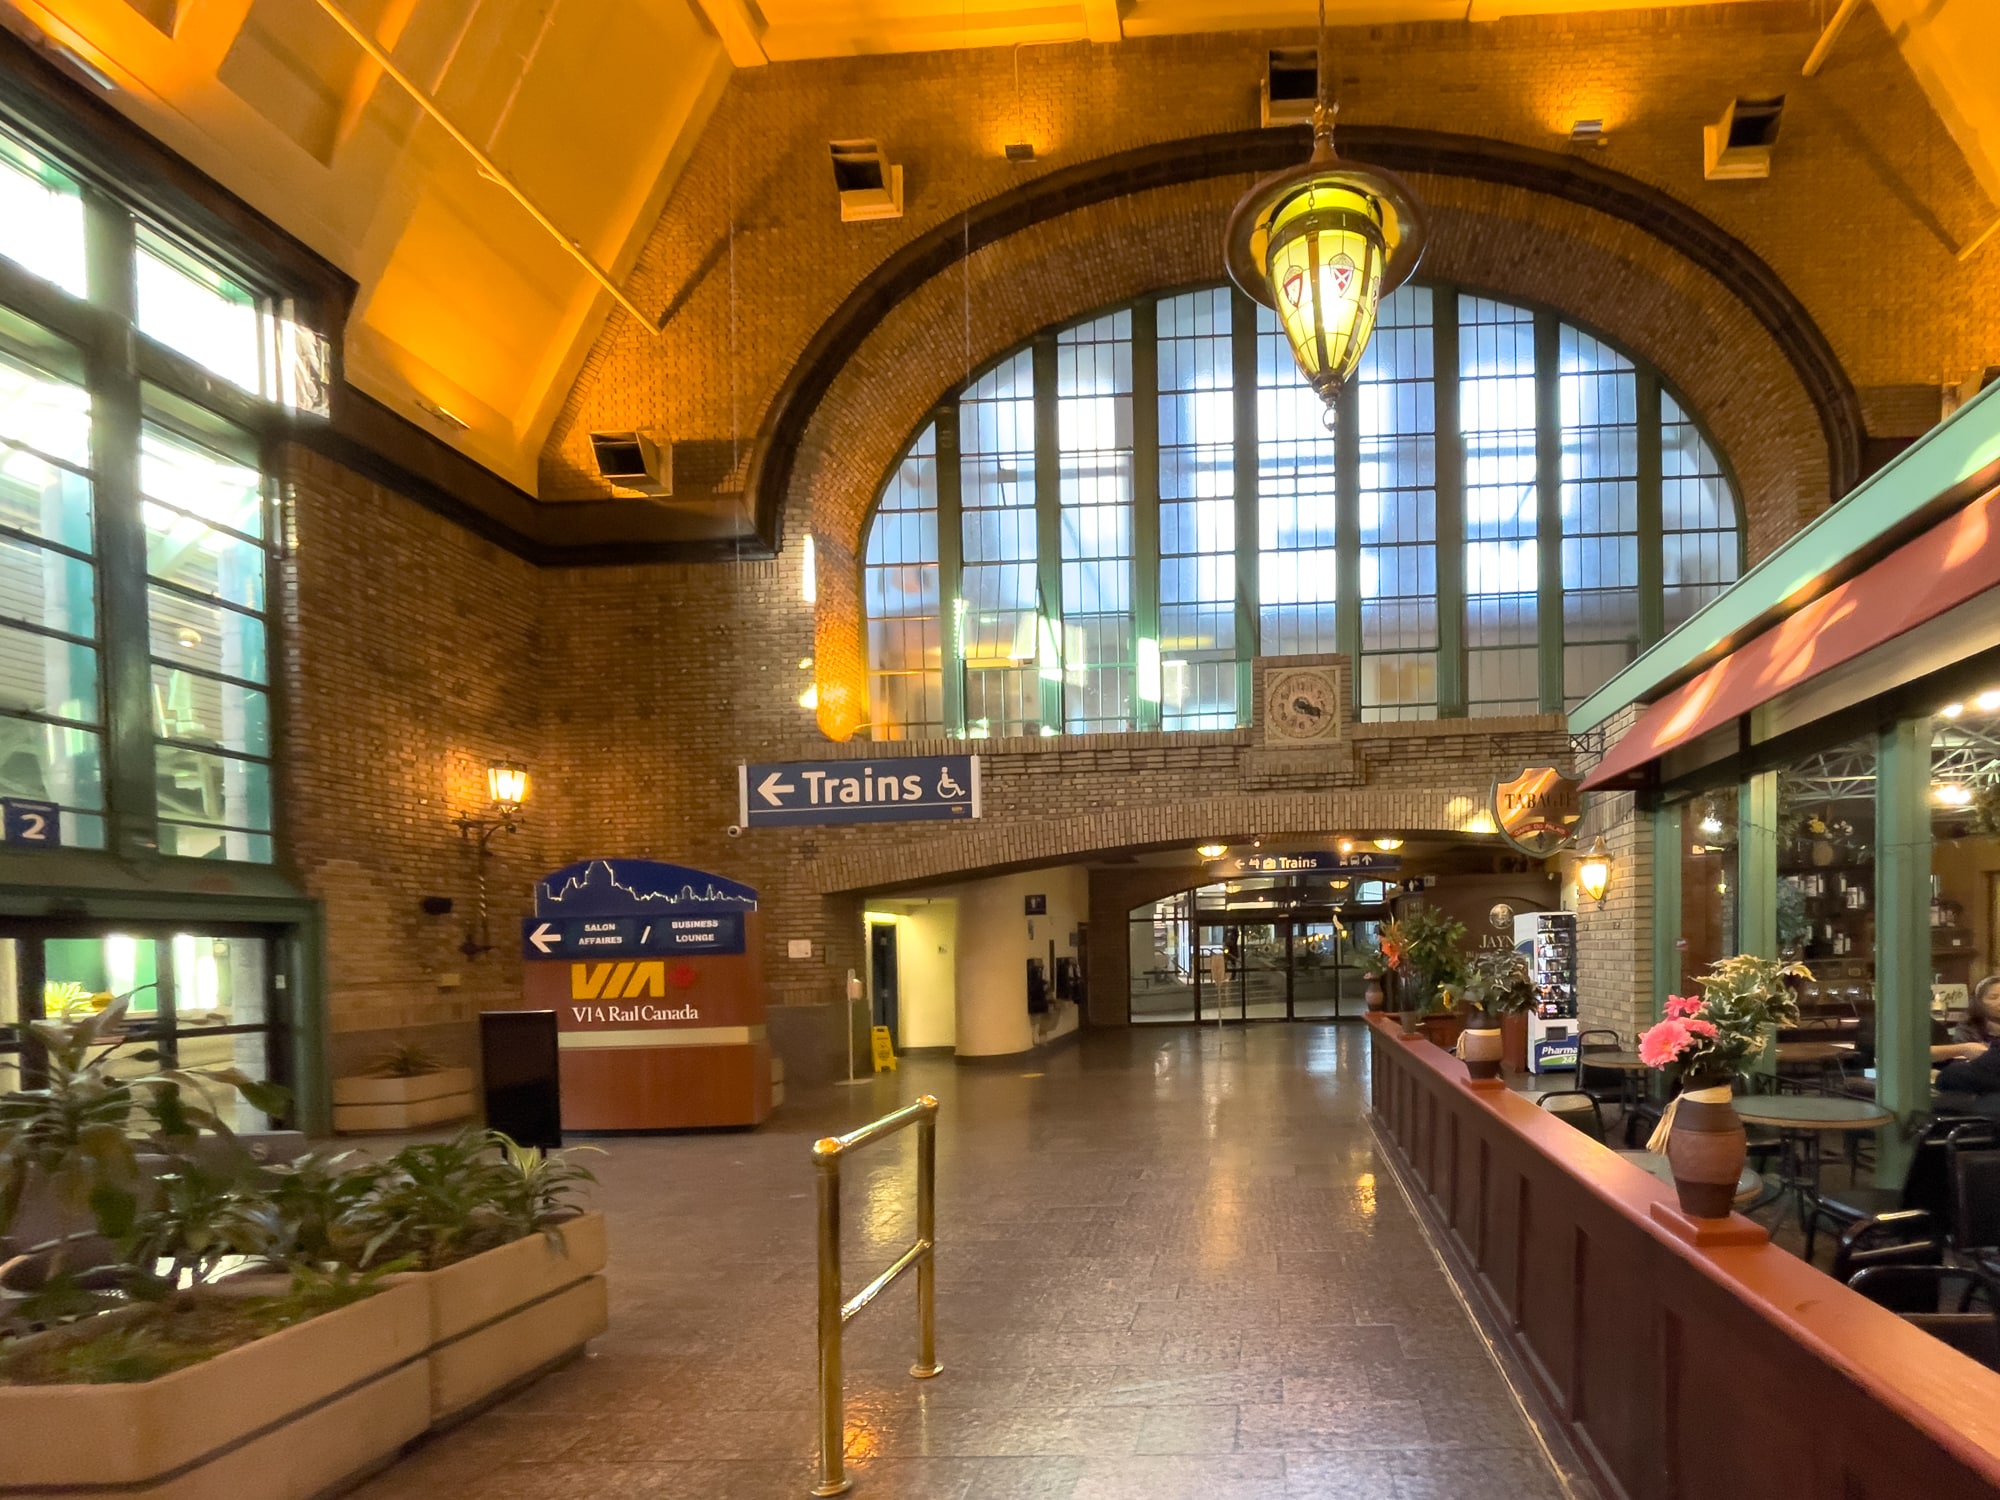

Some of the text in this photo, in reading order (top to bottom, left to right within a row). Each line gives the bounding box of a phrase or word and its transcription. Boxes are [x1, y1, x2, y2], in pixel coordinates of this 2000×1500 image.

[801, 767, 923, 804] Trains
[1505, 791, 1573, 809] TABAGIE
[21, 813, 46, 840] 2
[1279, 857, 1317, 869] Trains
[584, 923, 616, 932] SALON
[671, 920, 719, 929] BUSINESS
[578, 936, 623, 945] AFFAIRES
[675, 934, 715, 942] LOUNGE
[571, 961, 666, 1000] VIA
[571, 1004, 698, 1023] VIA Rail Canada
[1541, 1045, 1578, 1055] Pharma
